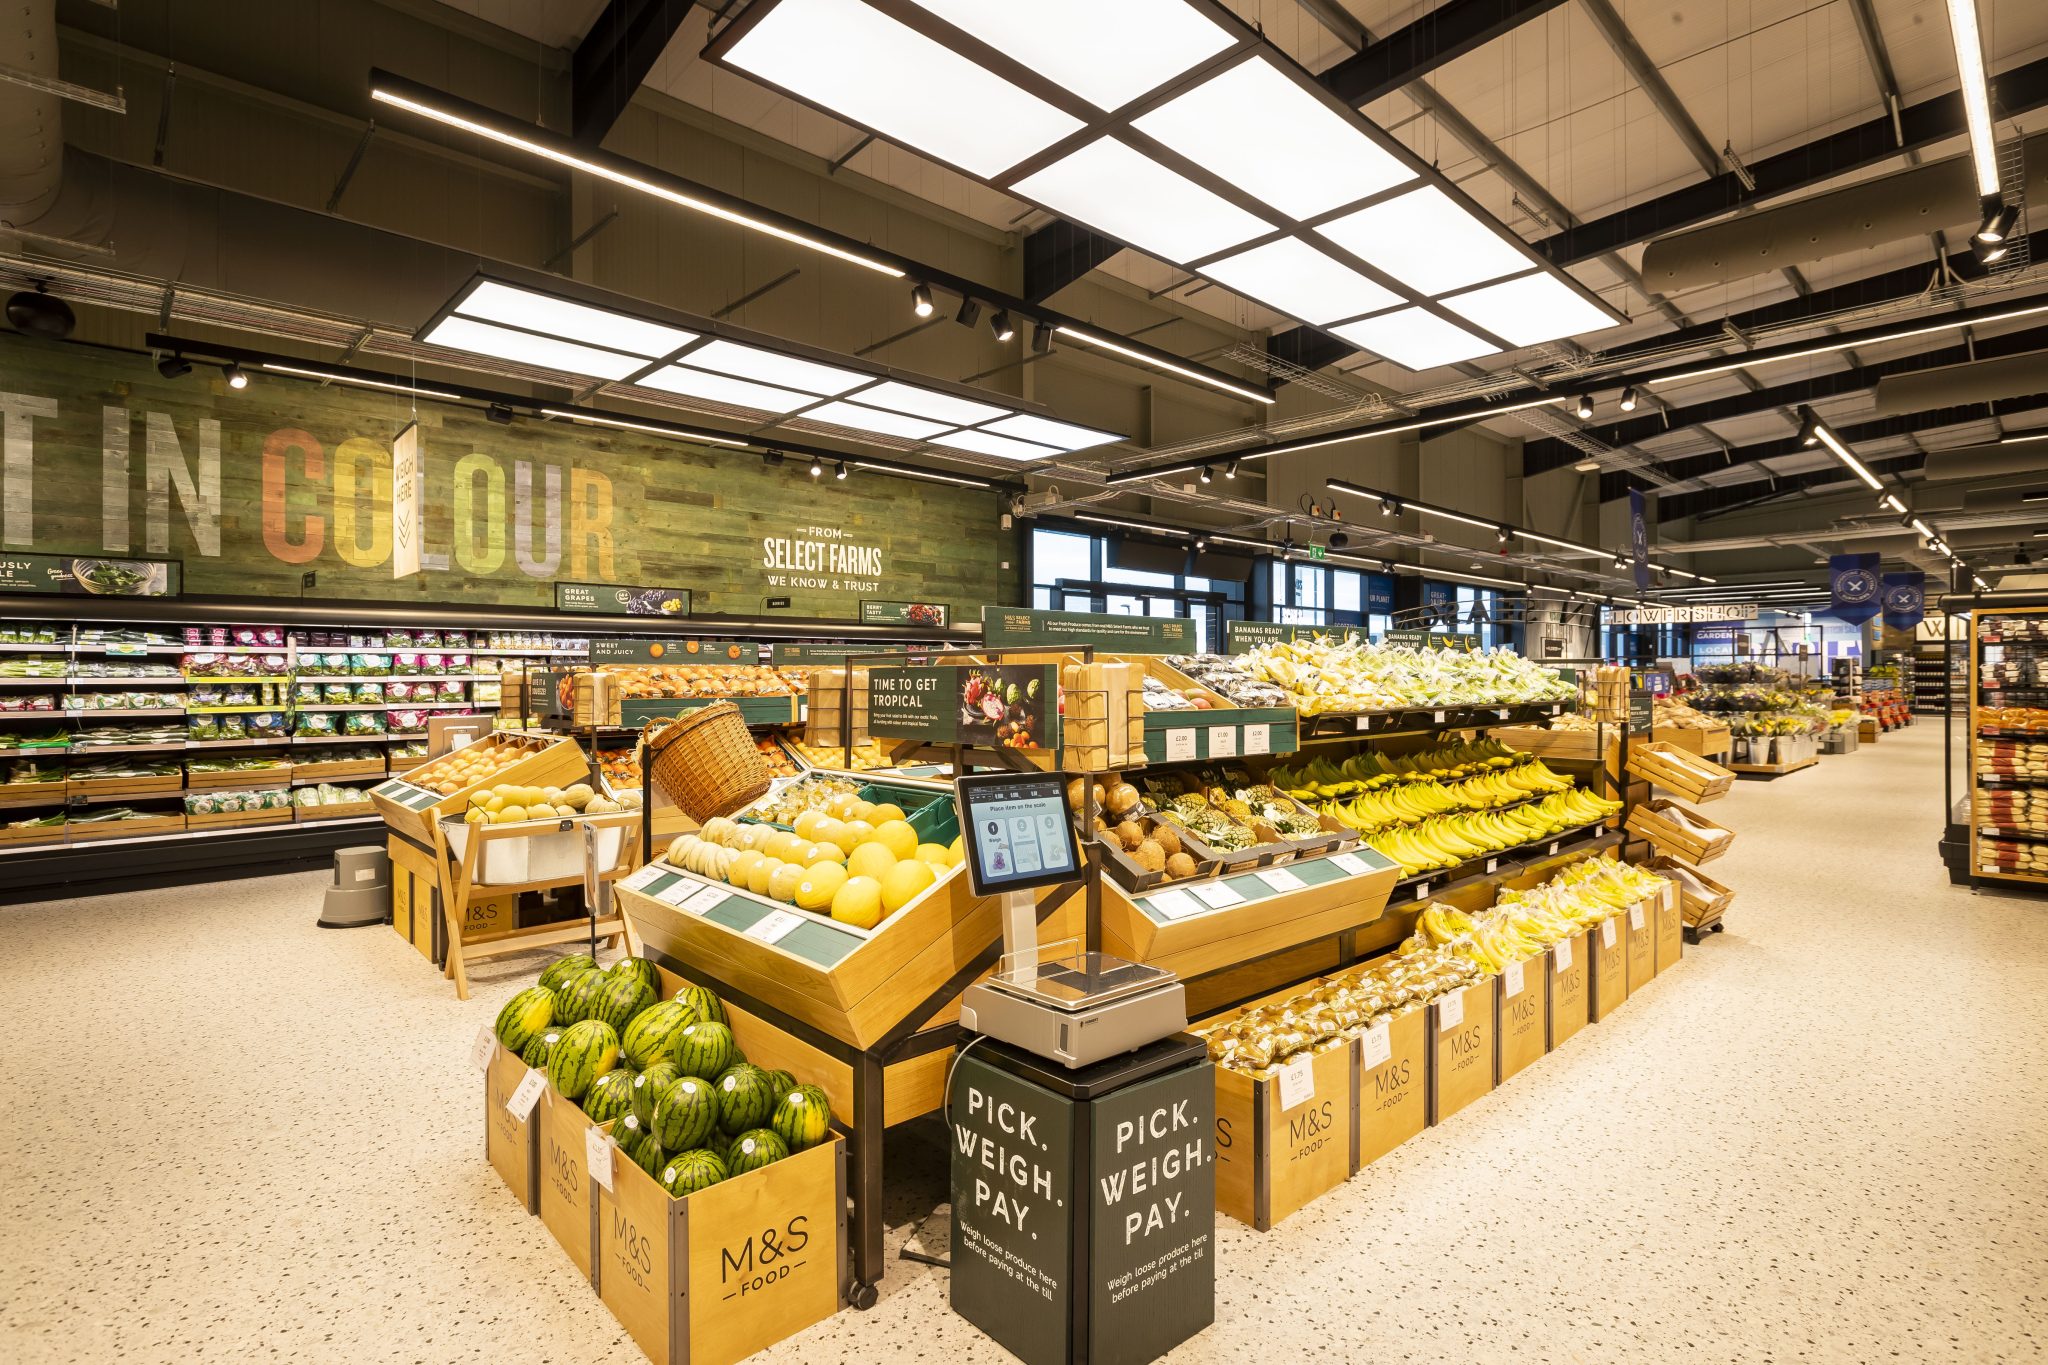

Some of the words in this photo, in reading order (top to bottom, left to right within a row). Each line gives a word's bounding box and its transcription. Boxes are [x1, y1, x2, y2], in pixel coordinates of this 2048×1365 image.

[395, 453, 413, 482] WEIGH
[103, 405, 221, 557] IN
[262, 428, 617, 582] COLOUR
[396, 479, 412, 504] HERE
[809, 526, 842, 539] FROM
[764, 537, 826, 571] SELECT
[829, 544, 882, 576] FARMS
[767, 575, 786, 586] WE
[791, 576, 827, 589] KNOW
[832, 580, 839, 590] &
[844, 581, 879, 592] TRUST
[1234, 626, 1263, 634] BANANAS
[1264, 627, 1283, 635] READY
[873, 679, 895, 691] TIME
[899, 679, 912, 691] TO
[916, 678, 937, 691] GET
[873, 694, 923, 708] TROPICAL
[464, 922, 488, 931] FOOD
[1562, 969, 1580, 999] M&S
[1512, 994, 1535, 1026] M&S
[1451, 1025, 1480, 1061] M&S
[1517, 1022, 1530, 1036] FOOD
[1375, 1059, 1410, 1100] M&S
[1457, 1055, 1474, 1071] FOOD
[968, 1087, 1048, 1151] PICK.
[1383, 1093, 1403, 1111] FOOD
[1116, 1099, 1198, 1154] PICK.
[1289, 1102, 1333, 1149] M&S
[550, 1136, 578, 1191] M&S
[955, 1123, 1063, 1207] WEIGH.
[1300, 1139, 1323, 1160] FOOD
[1101, 1138, 1212, 1206] WEIGH.
[556, 1181, 572, 1204] FOOD
[975, 1178, 1037, 1240] PAY.
[1125, 1191, 1190, 1245] PAY.
[614, 1207, 651, 1275] M&S
[722, 1215, 809, 1284] M&S
[960, 1220, 982, 1243] Weigh
[983, 1234, 1003, 1255] loose
[1005, 1249, 1037, 1276] produce
[1039, 1270, 1057, 1289] here
[622, 1258, 643, 1287] FOOD
[741, 1265, 790, 1296] FOOD
[964, 1236, 987, 1260] before
[988, 1254, 1014, 1277] paying
[1015, 1269, 1024, 1282] at
[1026, 1273, 1039, 1291] the
[1041, 1282, 1053, 1301] till
[1107, 1272, 1133, 1292] Weigh
[1135, 1259, 1156, 1276] loose
[1158, 1242, 1189, 1268] produce
[1191, 1233, 1208, 1249] here
[1112, 1283, 1139, 1304] before
[1141, 1268, 1167, 1290] paying
[1169, 1263, 1178, 1273] at
[1179, 1254, 1192, 1268] the
[1193, 1248, 1204, 1262] till
